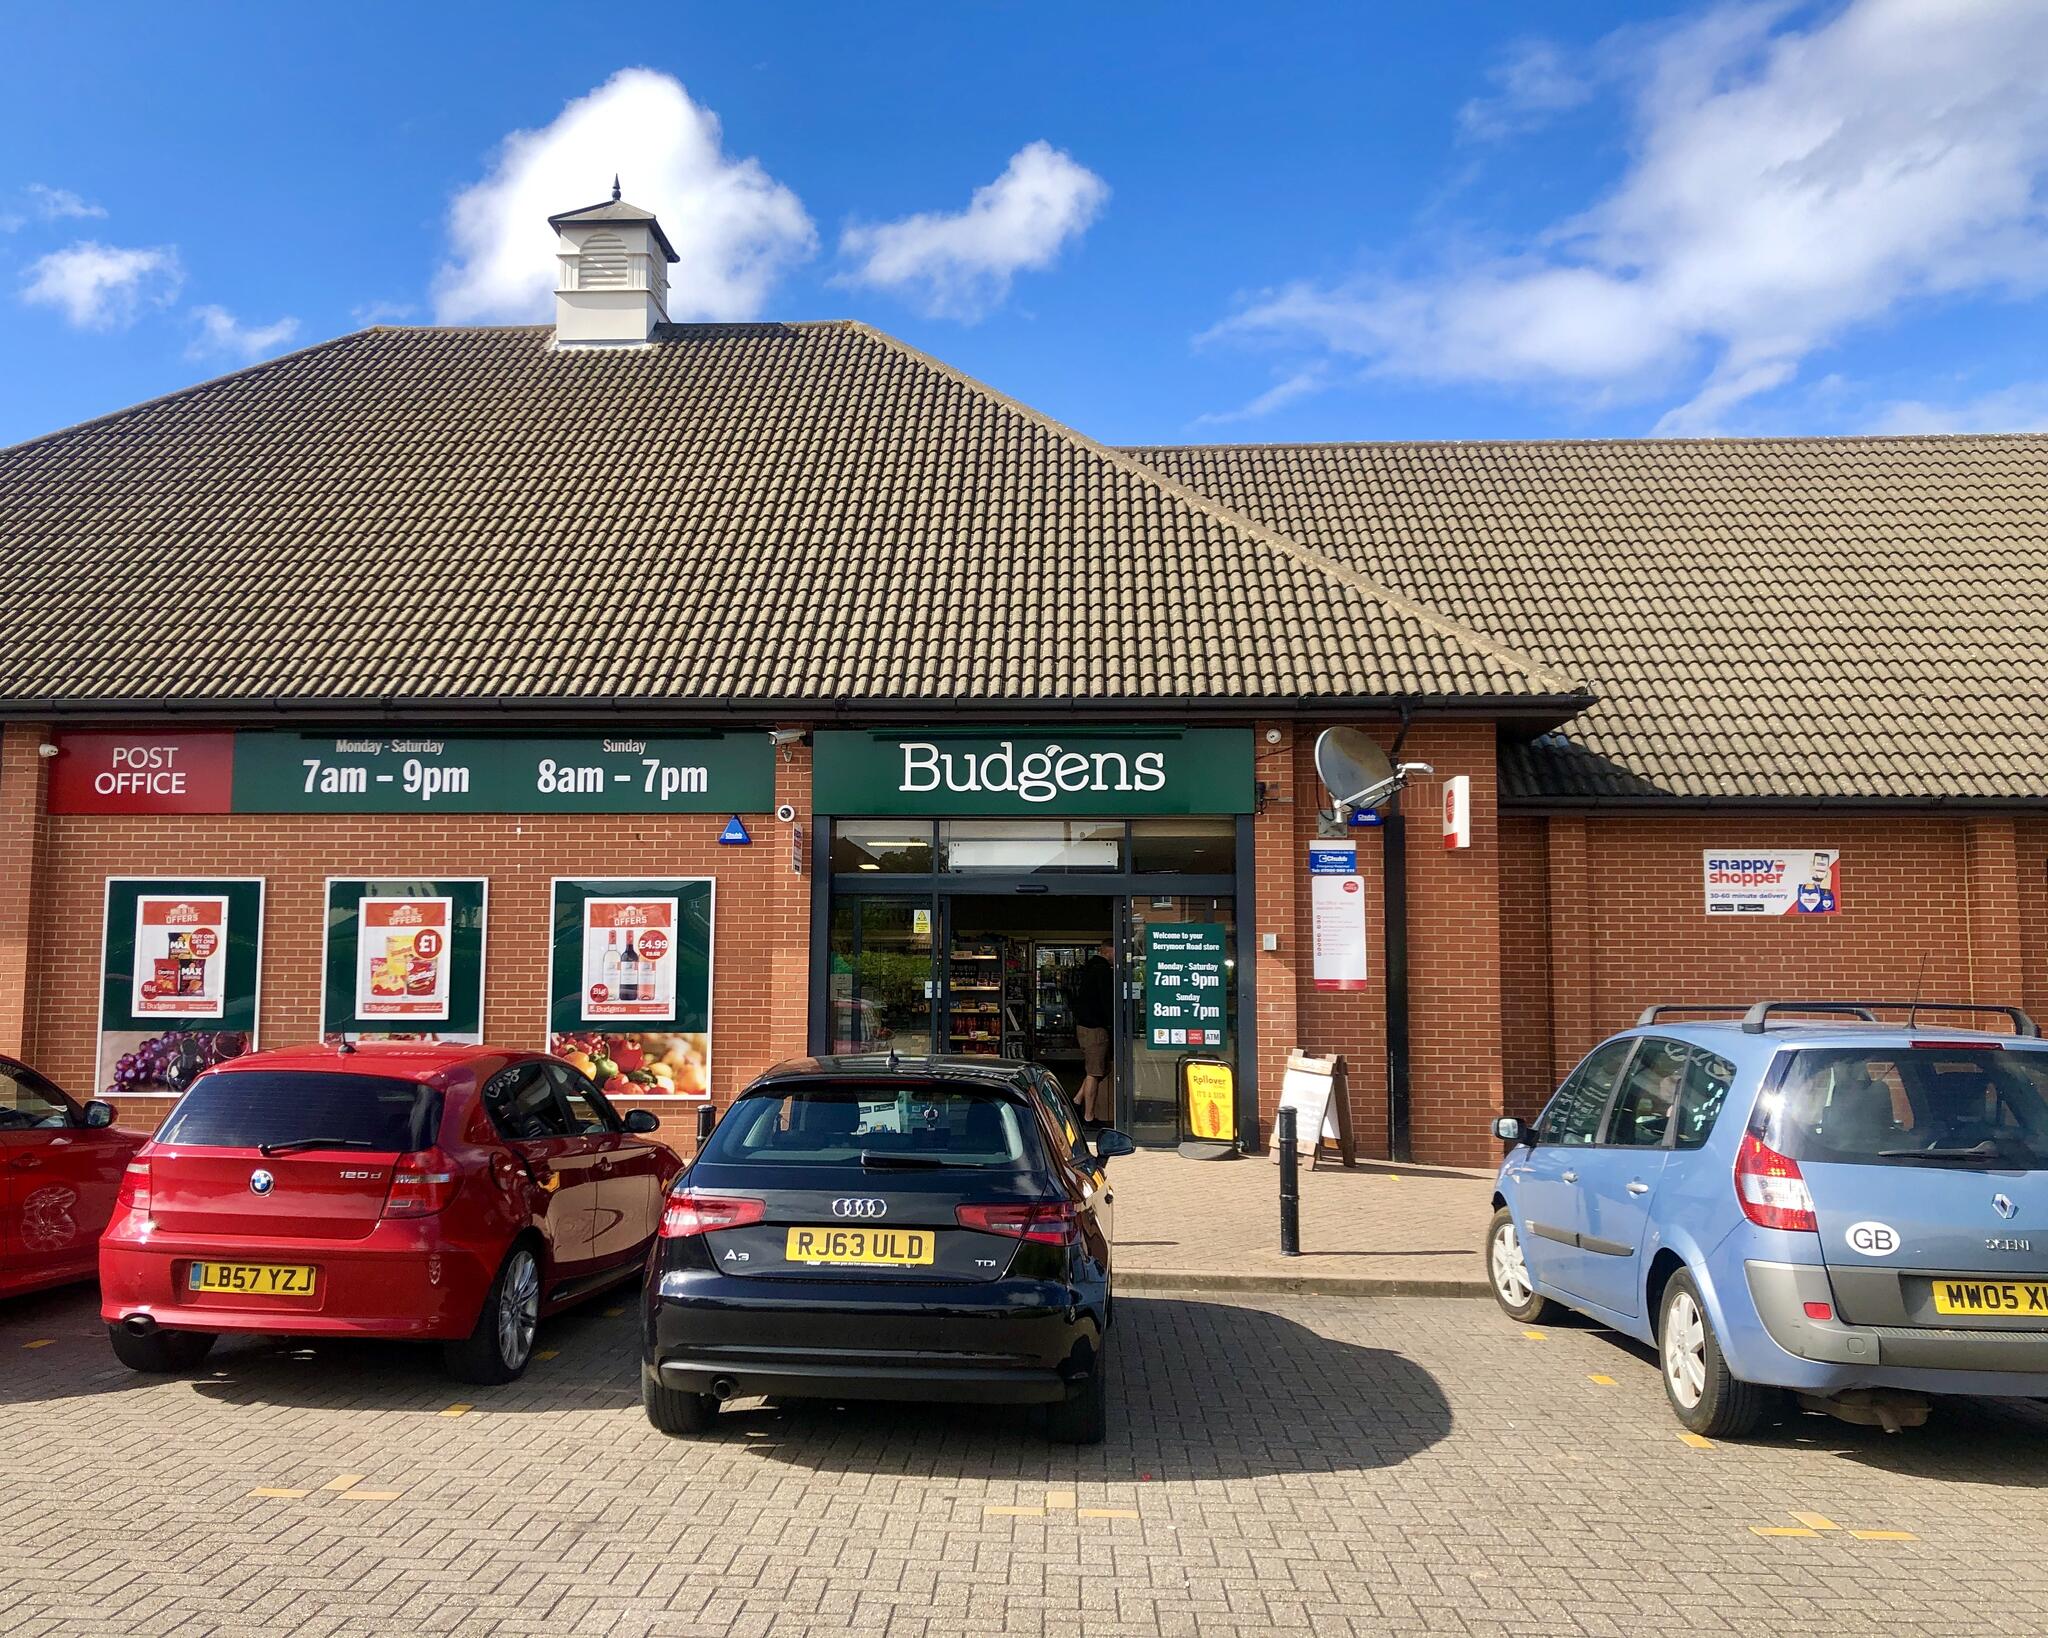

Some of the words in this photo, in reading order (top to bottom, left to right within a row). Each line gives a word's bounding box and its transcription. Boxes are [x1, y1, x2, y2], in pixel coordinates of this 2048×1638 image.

[336, 739, 382, 755] Monday
[391, 739, 444, 755] Saturday
[603, 738, 647, 755] Sunday
[112, 747, 179, 768] POST
[898, 741, 1166, 802] Budgens
[94, 772, 187, 794] OFFICE
[302, 759, 367, 793] 7am
[402, 759, 470, 801] 9pm
[537, 758, 604, 793] 8am
[642, 759, 708, 801] 7pm
[1708, 859, 1775, 873] snappy
[1709, 870, 1783, 887] shopper
[1759, 892, 1789, 900] delivery
[165, 914, 199, 924] OFFERS
[388, 915, 423, 926] OFFERS
[614, 916, 647, 926] OFFERS
[1152, 931, 1181, 939] Welcome
[419, 935, 437, 952] £1
[639, 940, 668, 949] £4.99
[1152, 942, 1185, 951] Berrymoor
[1203, 943, 1220, 951] store
[181, 967, 202, 976] MAX
[1157, 962, 1183, 971] Monday
[1188, 962, 1218, 972] Saturday
[1153, 972, 1181, 986] 7am
[1191, 972, 1219, 990] 9pm
[143, 984, 157, 993] Big
[593, 987, 607, 997] Big
[1176, 993, 1201, 1003] Sunday
[146, 1002, 176, 1010] Budgens
[596, 1006, 627, 1014] Budgens
[1153, 1002, 1181, 1017] 8am
[1192, 1002, 1220, 1020] 7pm
[1206, 1033, 1219, 1041] ATM
[1193, 1075, 1226, 1085] Rollover
[1853, 1228, 1893, 1250] GB
[798, 1231, 865, 1257] RJ63
[873, 1233, 923, 1259] ULD
[724, 1249, 750, 1261] A3
[974, 1259, 996, 1267] TDI
[203, 1265, 261, 1289] LB57
[268, 1268, 315, 1291] YZJ
[1946, 1284, 2019, 1310] MW05
